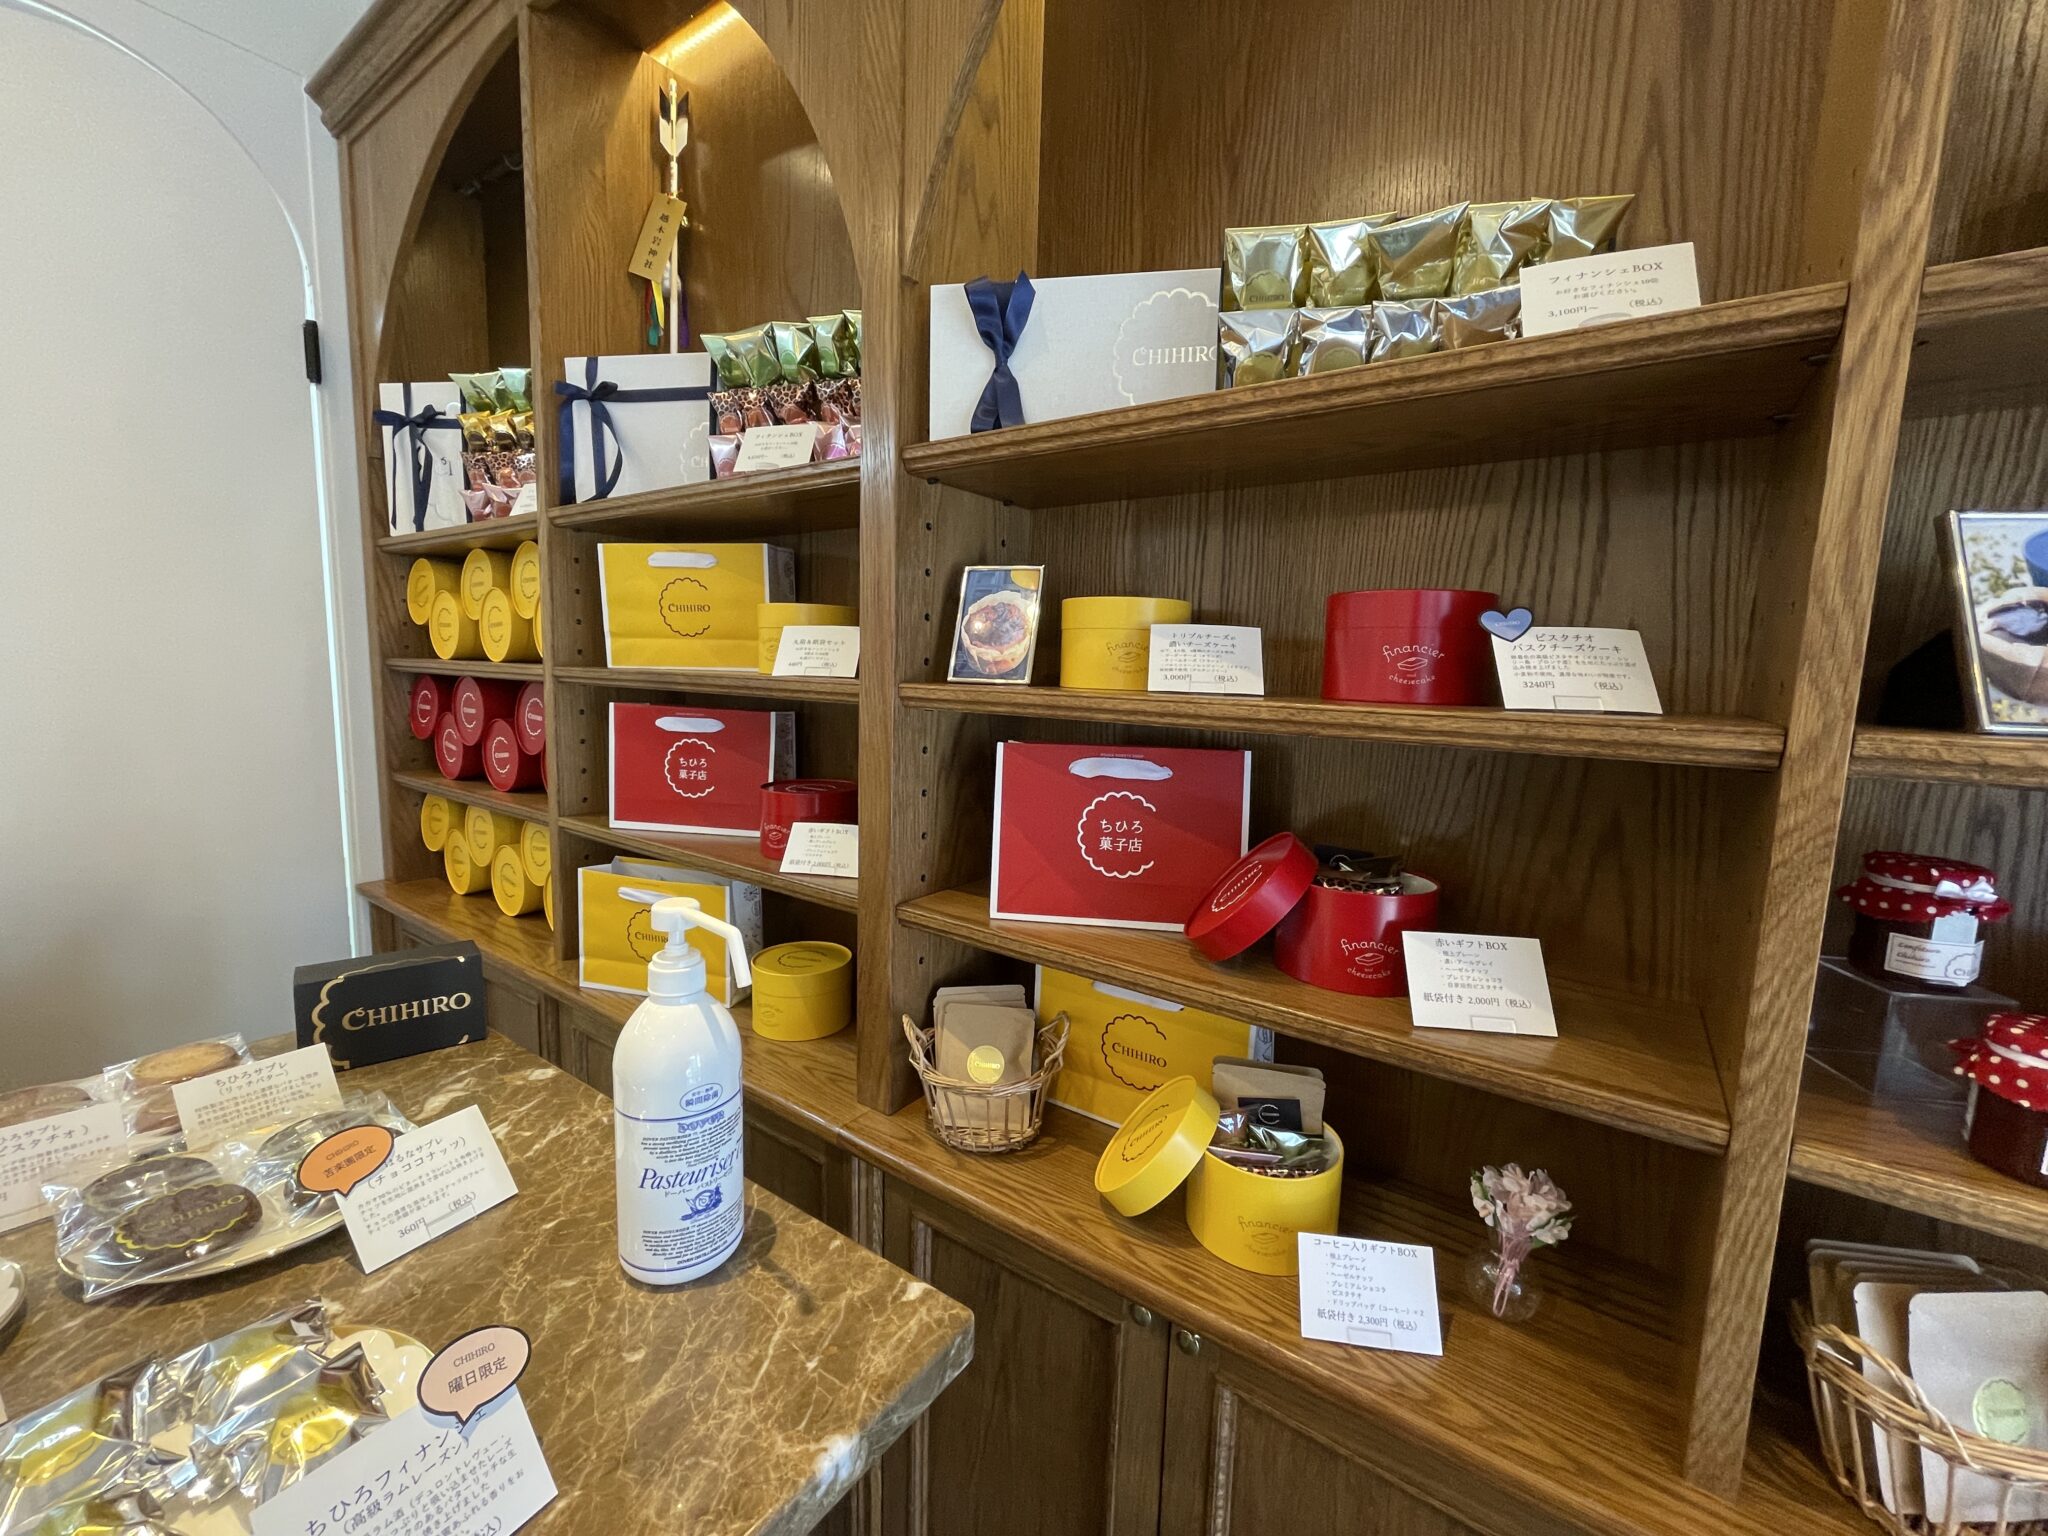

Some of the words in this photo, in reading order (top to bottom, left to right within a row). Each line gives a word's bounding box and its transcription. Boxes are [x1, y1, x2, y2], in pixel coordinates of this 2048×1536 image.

[1548, 261, 1665, 285] フィナンシェBOX
[668, 603, 711, 613] CHIHIRO
[1382, 643, 1446, 664] financier
[1512, 643, 1622, 654] バスクチーズケーキ
[1388, 672, 1436, 685] cheesecake
[678, 757, 708, 768] ちひろ
[678, 769, 708, 781] 菓子店
[1099, 818, 1144, 834] ちひろ
[1099, 836, 1143, 853] 菓子店
[634, 930, 668, 943] CHIHIR
[1340, 938, 1400, 956] financier
[1434, 937, 1509, 951] 赤いギフトBOX
[1423, 991, 1465, 1005] 紙袋付き
[341, 991, 472, 1031] CHIHIRO
[973, 1060, 1002, 1070] CHIHIRO
[1111, 1041, 1168, 1069] CHIHIRO
[215, 1061, 288, 1088] ちひろサブレ
[323, 1144, 377, 1179] 苦楽園限定
[638, 1147, 737, 1190] Pasteuriser
[397, 1215, 427, 1239] 360円
[1313, 1238, 1419, 1259] コーヒー入りギフトBOX
[1317, 1307, 1355, 1323] 紙袋付き
[1358, 1315, 1389, 1328] 2,300円
[453, 1342, 496, 1368] CHIHIRO
[447, 1355, 509, 1395] 曜日限定
[343, 1435, 471, 1534] （高級ラムレーズン）
